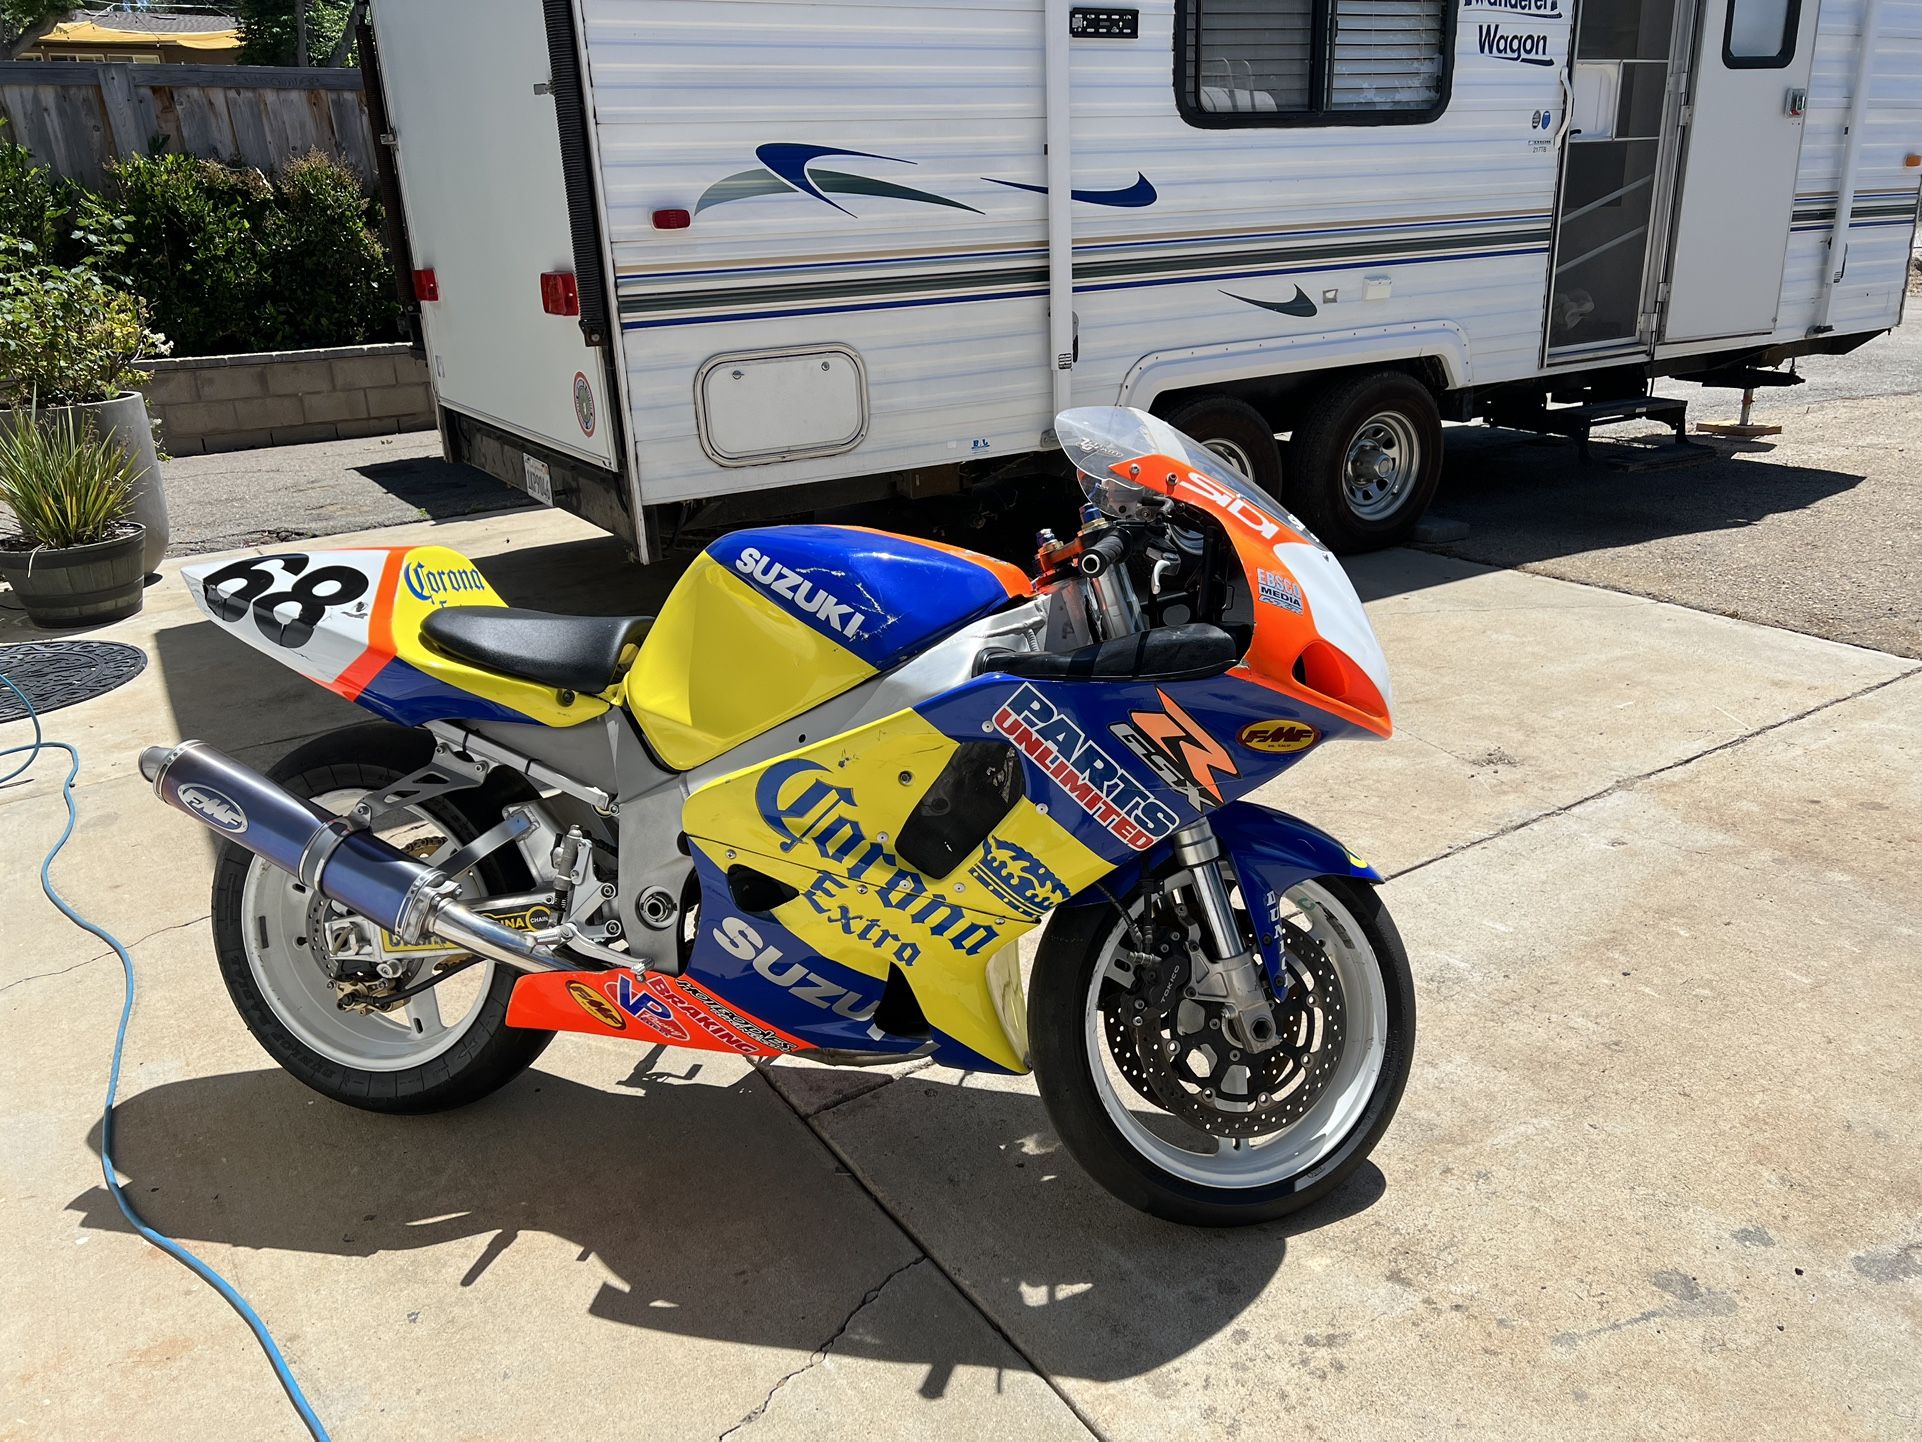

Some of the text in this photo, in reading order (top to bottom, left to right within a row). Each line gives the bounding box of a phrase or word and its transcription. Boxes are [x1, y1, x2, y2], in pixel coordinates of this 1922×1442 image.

[1478, 24, 1548, 61] Wagon
[404, 561, 484, 605] Corona
[734, 547, 866, 638] SUZUKI
[1260, 586, 1301, 606] MEDIA
[1244, 726, 1313, 743] FMF
[992, 706, 1155, 851] UNLIMITED
[1005, 682, 1180, 838] PARTS
[182, 788, 243, 826] FMF
[755, 758, 999, 956] Corona
[530, 916, 550, 924] CHAIN
[800, 870, 921, 966] Extra
[569, 986, 621, 1026] FMF
[617, 974, 674, 1018] VP
[712, 917, 941, 1054] SUZU
[1160, 965, 1180, 1003] TOKICO
[646, 976, 760, 1053] BRAKING
